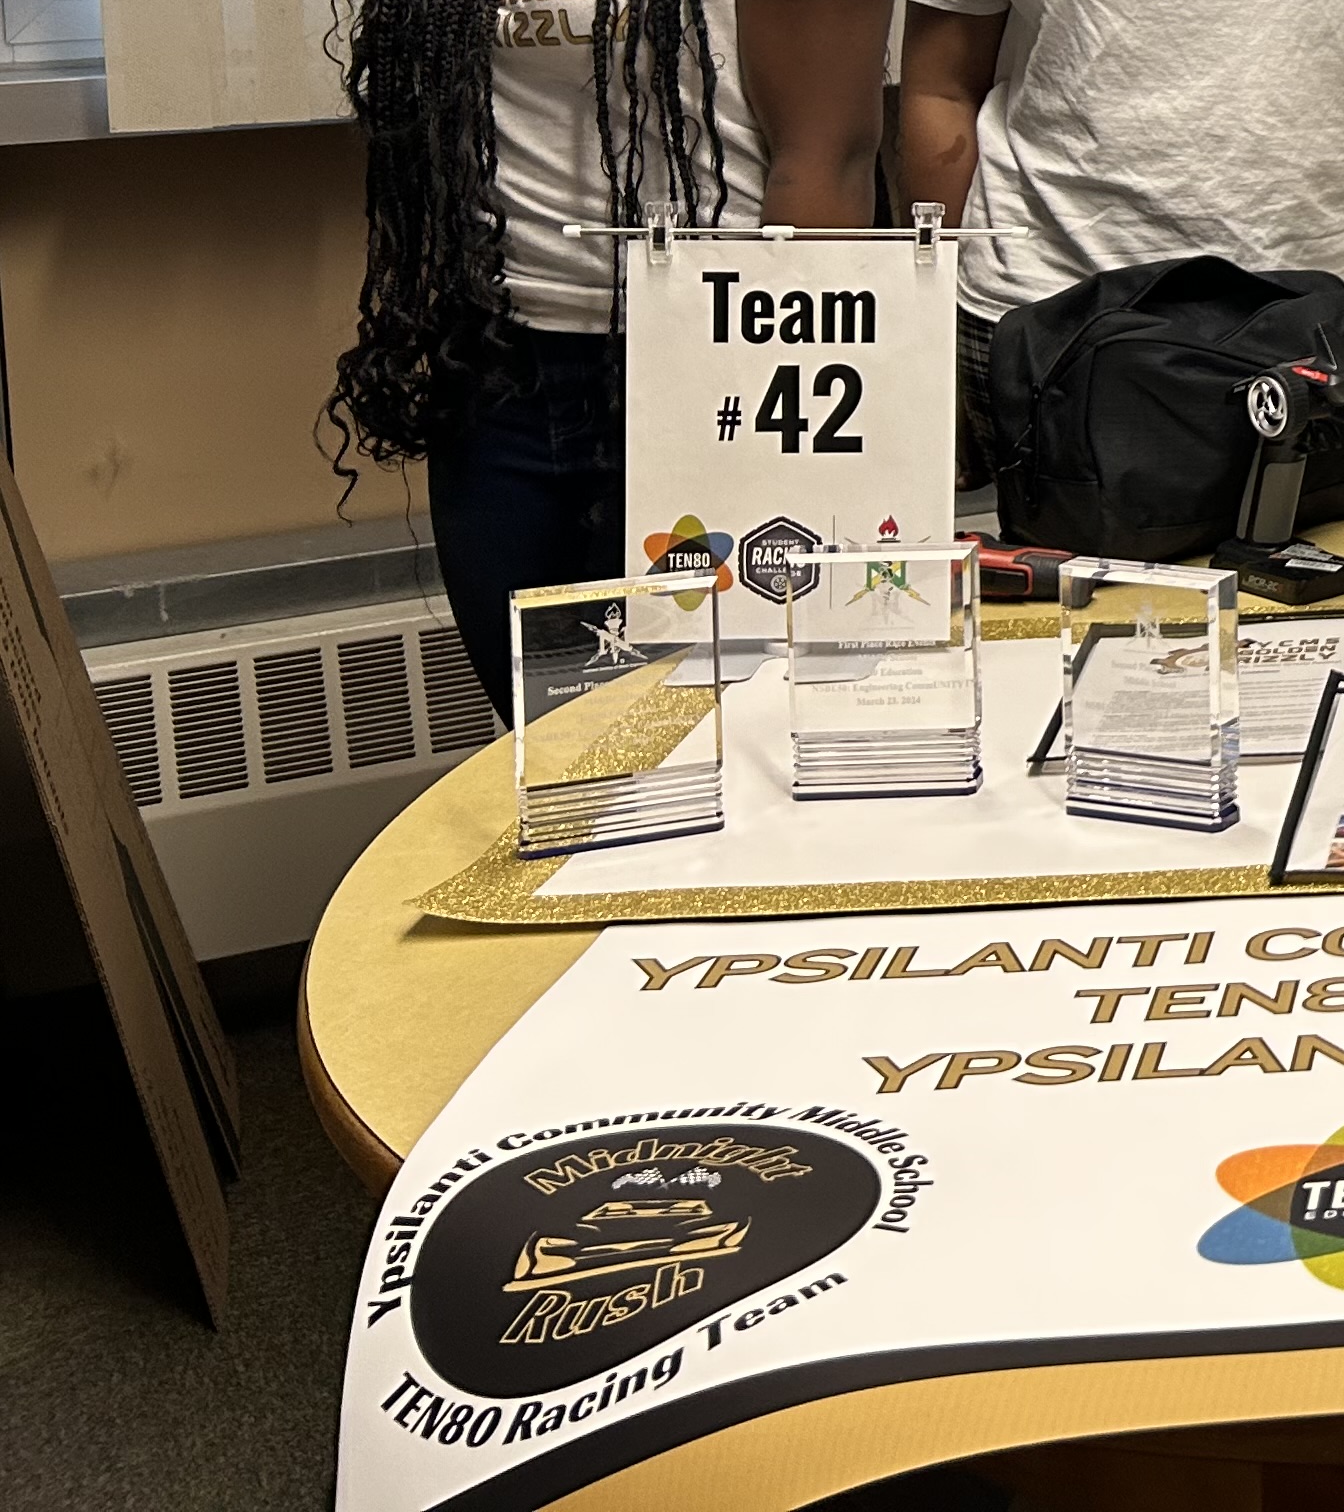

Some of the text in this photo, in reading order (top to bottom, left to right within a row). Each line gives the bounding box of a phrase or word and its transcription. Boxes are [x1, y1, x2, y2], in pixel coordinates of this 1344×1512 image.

[702, 271, 877, 346] Team
[667, 552, 711, 568] TEN80
[838, 641, 858, 650] First
[547, 683, 582, 696] Second
[632, 930, 1215, 992] YPSILANTI
[523, 1136, 813, 1198] Midnight
[366, 1101, 935, 1330] Ypsilanti Community Middle School
[499, 1260, 706, 1344] Rush
[380, 1269, 849, 1448] TEN80 Racing Team
